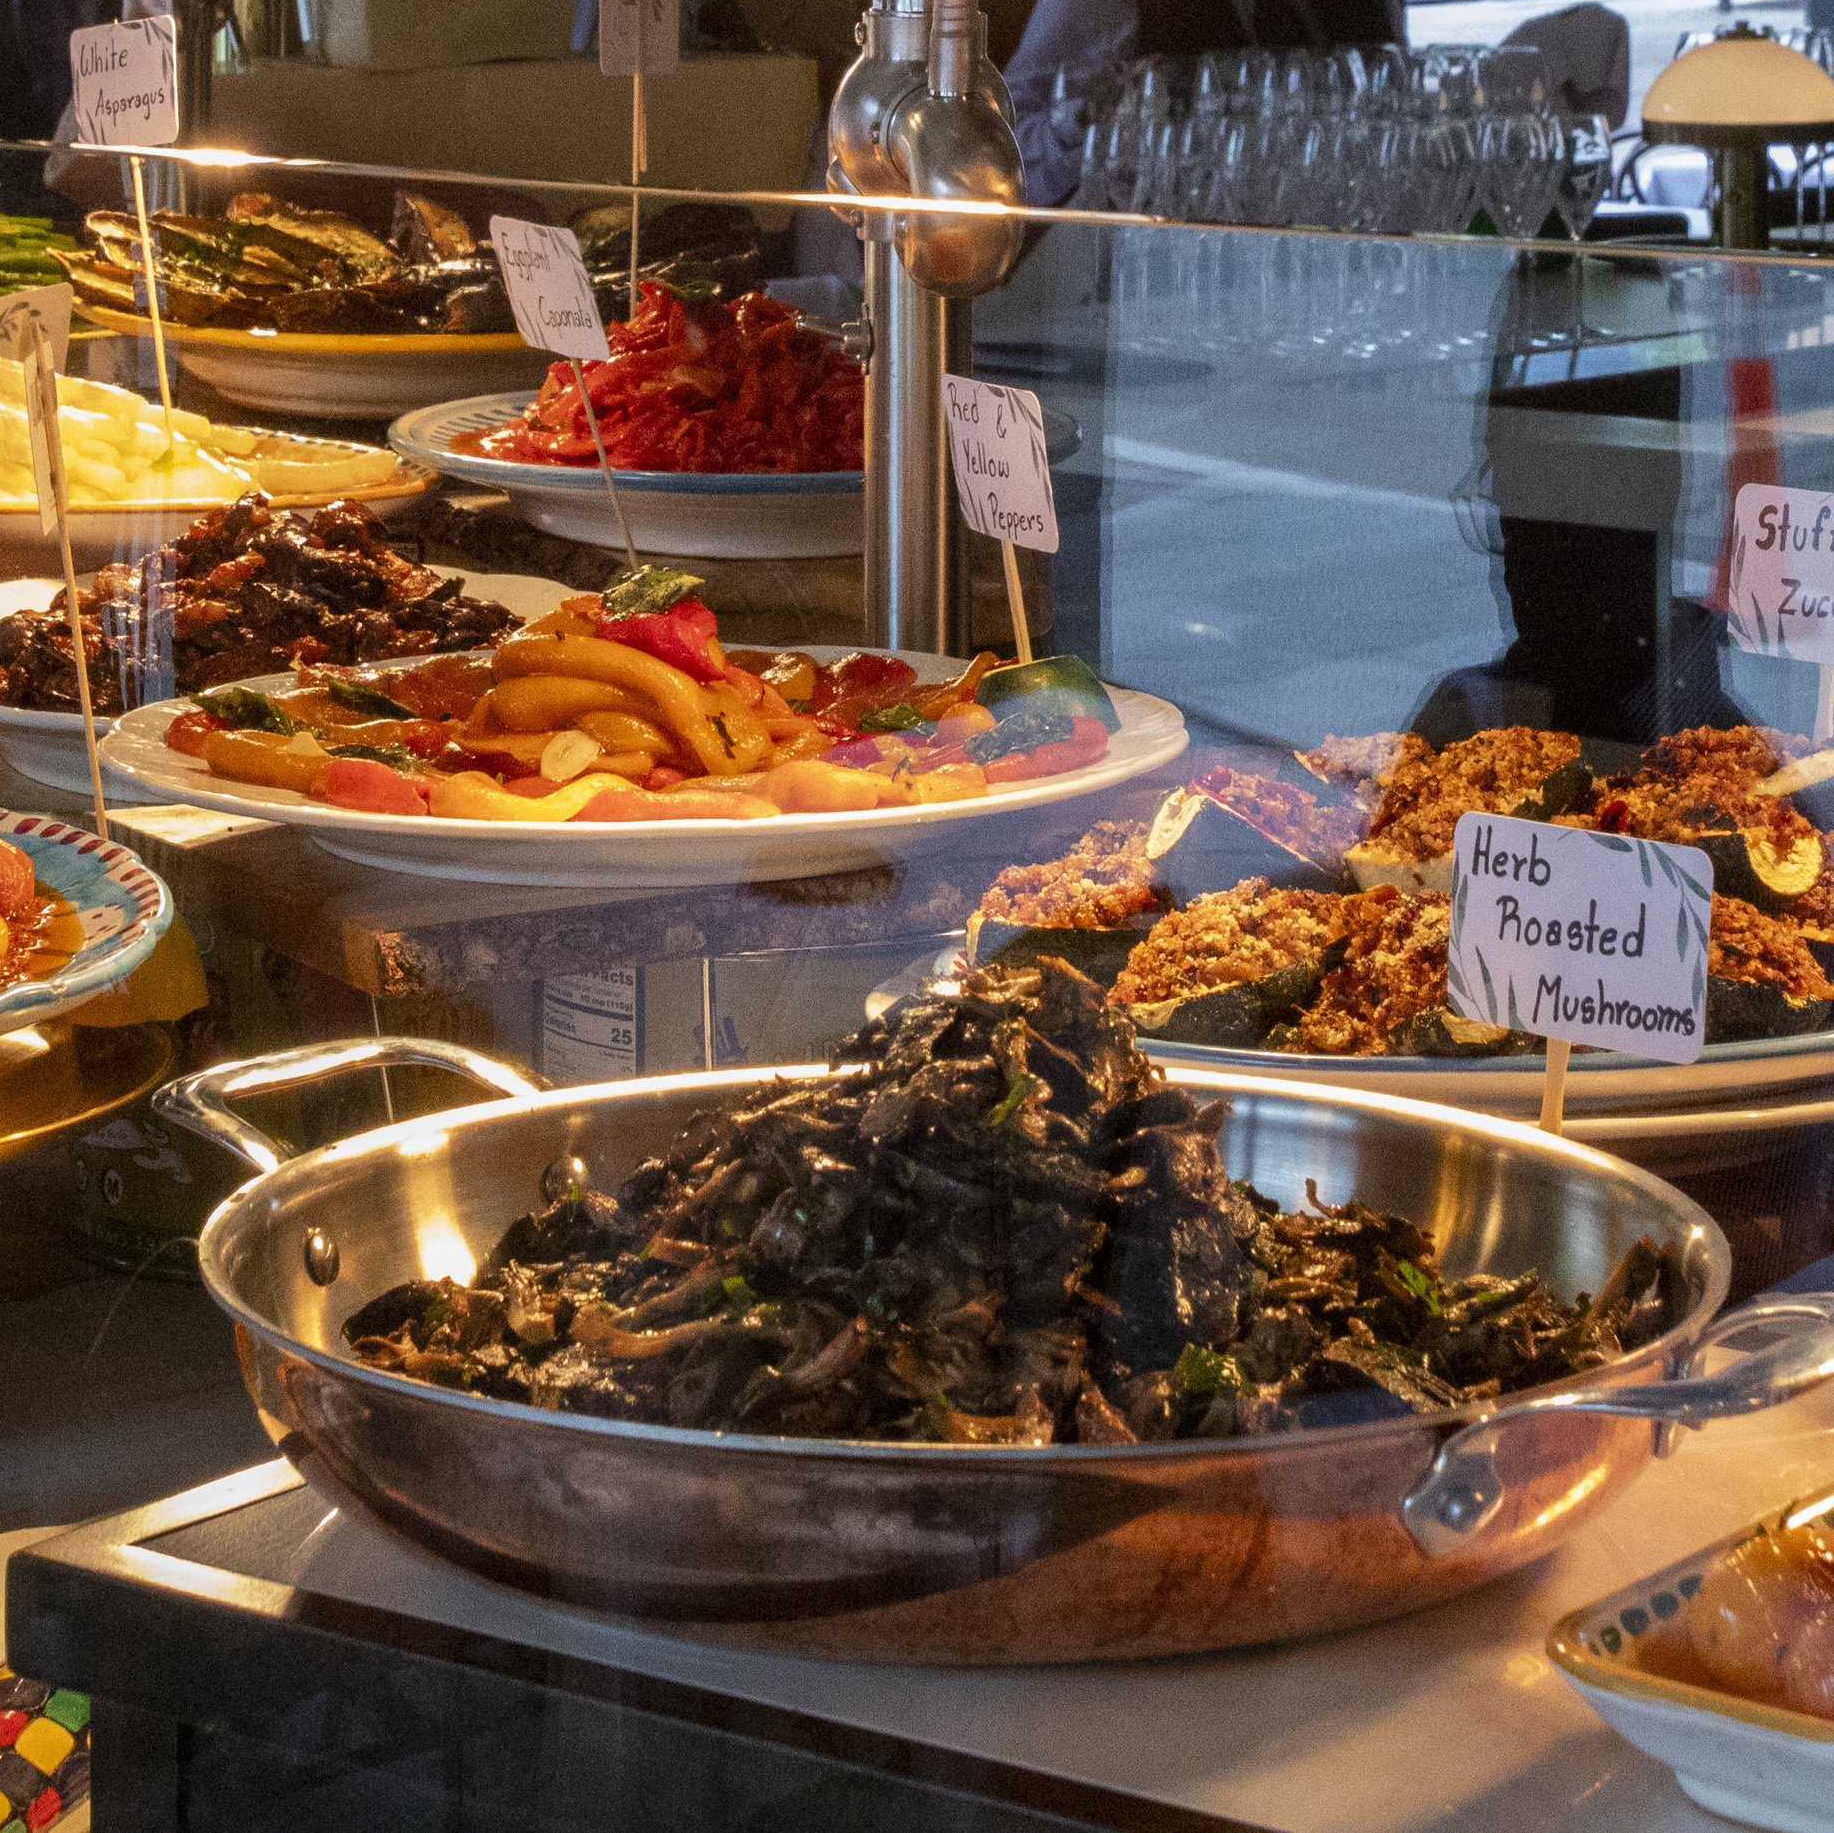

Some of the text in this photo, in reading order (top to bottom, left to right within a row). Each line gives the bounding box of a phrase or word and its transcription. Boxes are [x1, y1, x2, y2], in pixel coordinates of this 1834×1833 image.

[80, 38, 128, 77] White
[95, 87, 165, 127] Asparagus
[501, 230, 551, 282] Eggplant
[538, 295, 593, 340] Caponata
[948, 382, 1007, 439] Red &
[962, 439, 1010, 479] Yellow
[987, 491, 1044, 540] Peppers
[1472, 825, 1551, 886] Herb
[1496, 895, 1646, 958] Roasted
[1532, 974, 1696, 1036] Mushrooms
[611, 1028, 633, 1046] 25
